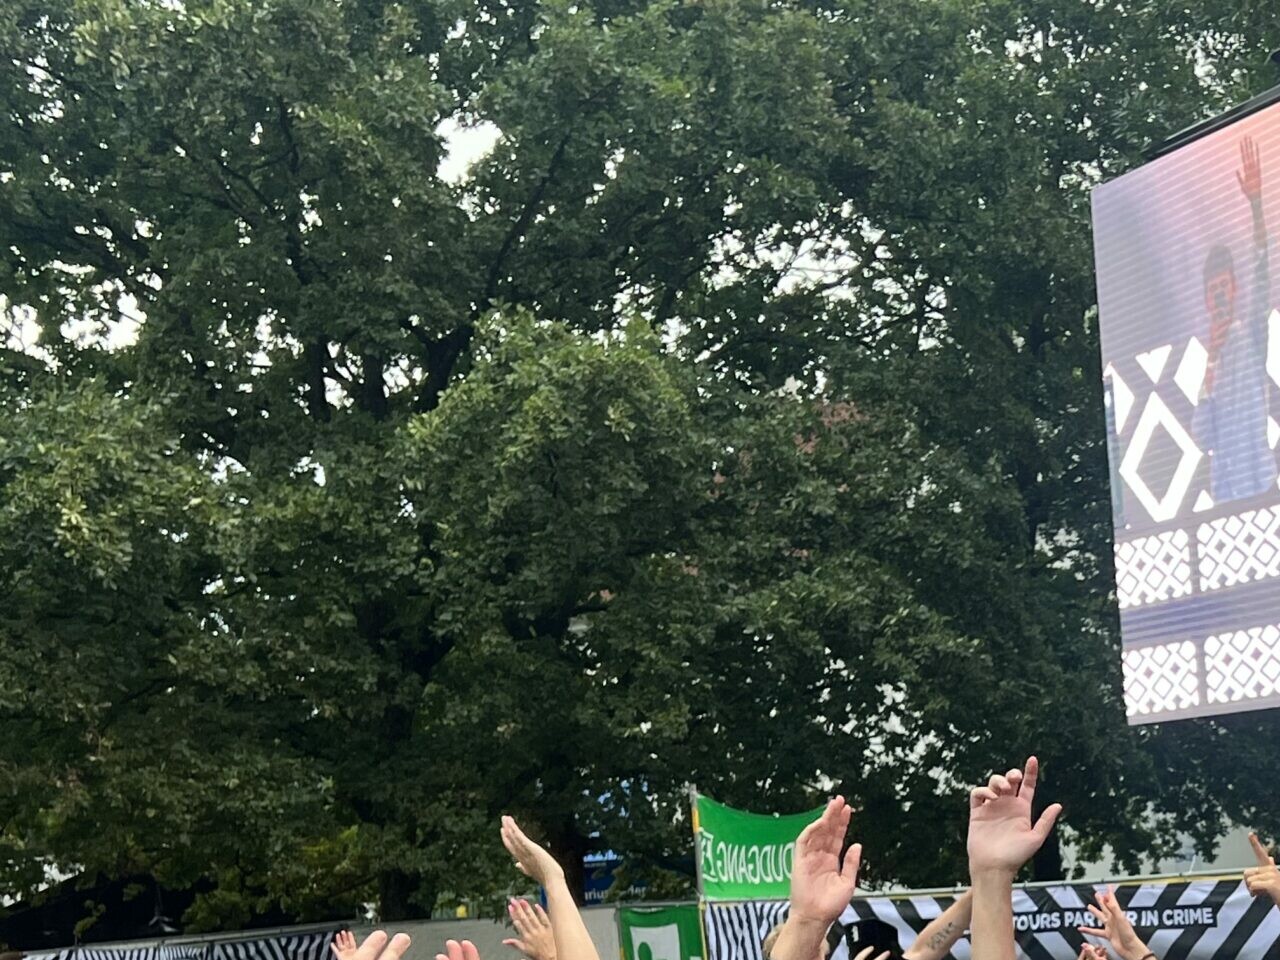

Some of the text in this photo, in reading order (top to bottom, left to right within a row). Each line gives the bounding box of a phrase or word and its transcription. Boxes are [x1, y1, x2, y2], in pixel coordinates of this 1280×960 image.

[1064, 909, 1138, 928] PARR
[1140, 909, 1159, 927] IN
[1162, 907, 1214, 926] CRIME
